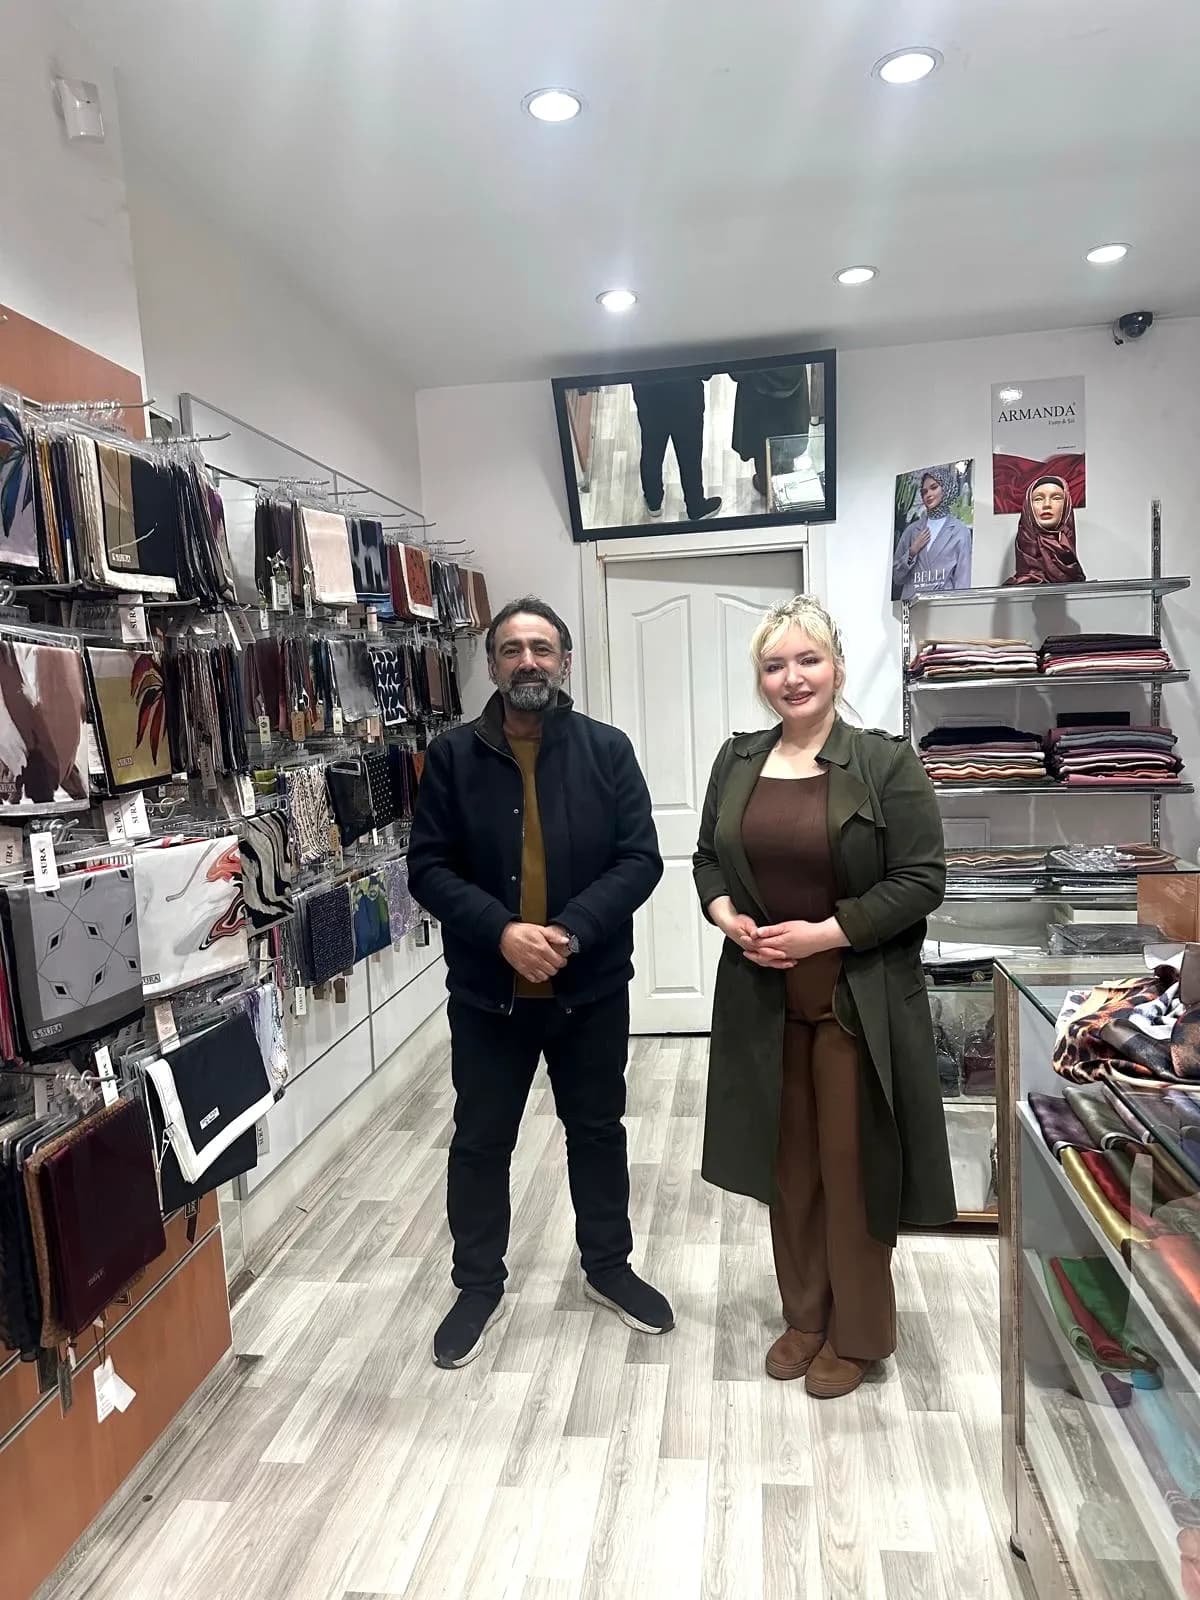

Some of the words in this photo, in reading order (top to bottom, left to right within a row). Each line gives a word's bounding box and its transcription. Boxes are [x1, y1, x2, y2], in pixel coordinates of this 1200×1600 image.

[998, 404, 1075, 422] ARMANDA
[128, 606, 137, 629] SURA
[113, 810, 123, 834] SURA
[129, 801, 139, 824] SURA
[6, 844, 14, 864] URA
[40, 847, 48, 875] SURA
[142, 975, 159, 985] URA
[39, 1024, 62, 1037] SURA
